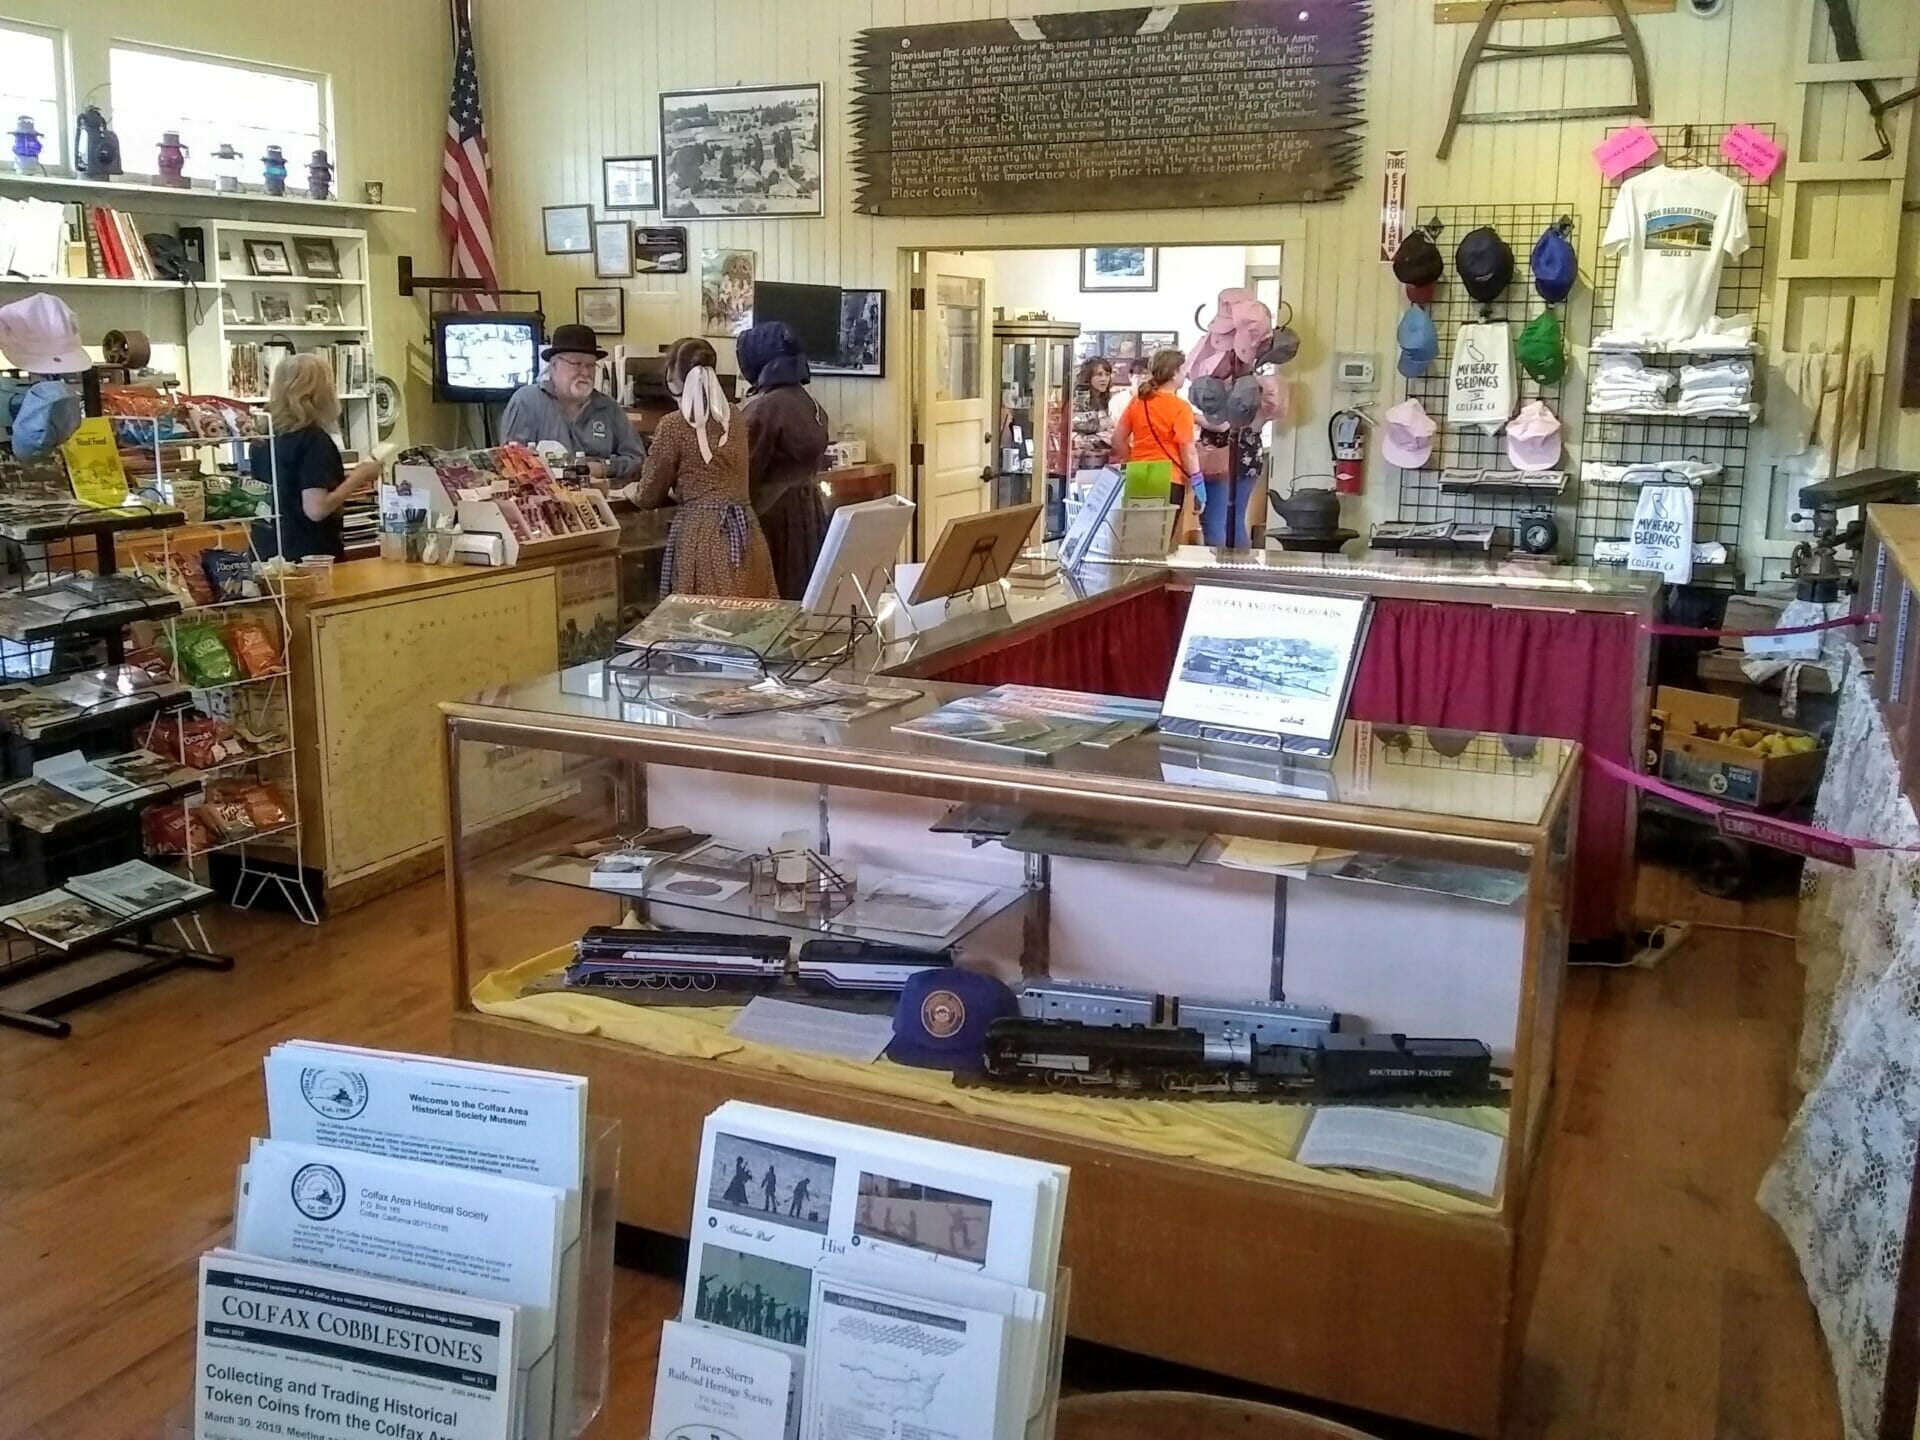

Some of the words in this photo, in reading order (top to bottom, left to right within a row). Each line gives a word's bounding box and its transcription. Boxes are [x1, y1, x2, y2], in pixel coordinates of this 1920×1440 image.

[962, 45, 986, 55] called
[1040, 40, 1053, 49] Was
[1109, 34, 1128, 45] 1849
[1131, 32, 1157, 43] when
[1165, 42, 1183, 52] and
[1271, 34, 1288, 43] the
[972, 75, 988, 83] and
[1000, 90, 1056, 102] November
[1063, 88, 1080, 98] the
[1083, 86, 1125, 97] Indians
[1130, 83, 1162, 96] began
[1258, 79, 1273, 87] on
[944, 115, 970, 125] called
[979, 113, 995, 123] the
[1018, 120, 1060, 132] Indians
[962, 151, 1019, 165] Apparently
[1387, 158, 1405, 169] FIRE
[980, 172, 998, 181] the
[1004, 169, 1064, 183] importance
[1109, 166, 1141, 177] place
[891, 187, 928, 198] Placer
[933, 187, 978, 198] County
[1388, 172, 1399, 253] EXTINGUISHER
[1662, 206, 1692, 216] RAILROAD
[1692, 208, 1718, 221] STATION
[1660, 250, 1682, 258] COLFAX
[1684, 250, 1692, 258] CA
[1456, 363, 1469, 376] MY
[1470, 362, 1499, 374] HEART
[1455, 376, 1499, 390] BELONGS
[1486, 402, 1496, 410] CA
[1636, 518, 1652, 530] MY
[1652, 520, 1684, 534] HEART
[1634, 532, 1682, 550] BELONGS
[1632, 559, 1660, 568] COLFAX
[1664, 562, 1674, 570] CA
[670, 596, 718, 605] UNION
[719, 598, 778, 608] PACIFIC
[1368, 1068, 1415, 1076] SOUTHERN
[409, 1093, 448, 1108] Welcome
[451, 1100, 462, 1108] to
[464, 1100, 476, 1110] the
[478, 1102, 506, 1114] Colfax
[508, 1106, 528, 1116] Area
[412, 1104, 454, 1117] Historical
[456, 1110, 488, 1123] Society
[490, 1114, 528, 1126] Museum
[361, 1188, 388, 1202] Colfax
[390, 1193, 410, 1206] Area
[413, 1196, 454, 1215] Historical
[456, 1206, 489, 1223] Society
[314, 1290, 330, 1300] Colfax
[222, 1296, 310, 1330] COLFAX
[318, 1312, 483, 1364] COBBLESTONES
[690, 1356, 754, 1386] Placer-Sierra
[668, 1368, 702, 1388] Railroad
[706, 1379, 740, 1397] Heritage
[744, 1388, 774, 1407] Society
[206, 1364, 284, 1393] Collecting
[288, 1377, 316, 1396] and
[322, 1384, 380, 1413] Trading
[384, 1397, 458, 1427] Historical
[204, 1410, 234, 1424] March
[205, 1386, 252, 1407] Token
[258, 1394, 300, 1416] Coins
[304, 1403, 341, 1426] from
[346, 1409, 371, 1431] the
[375, 1418, 424, 1440] Colfax
